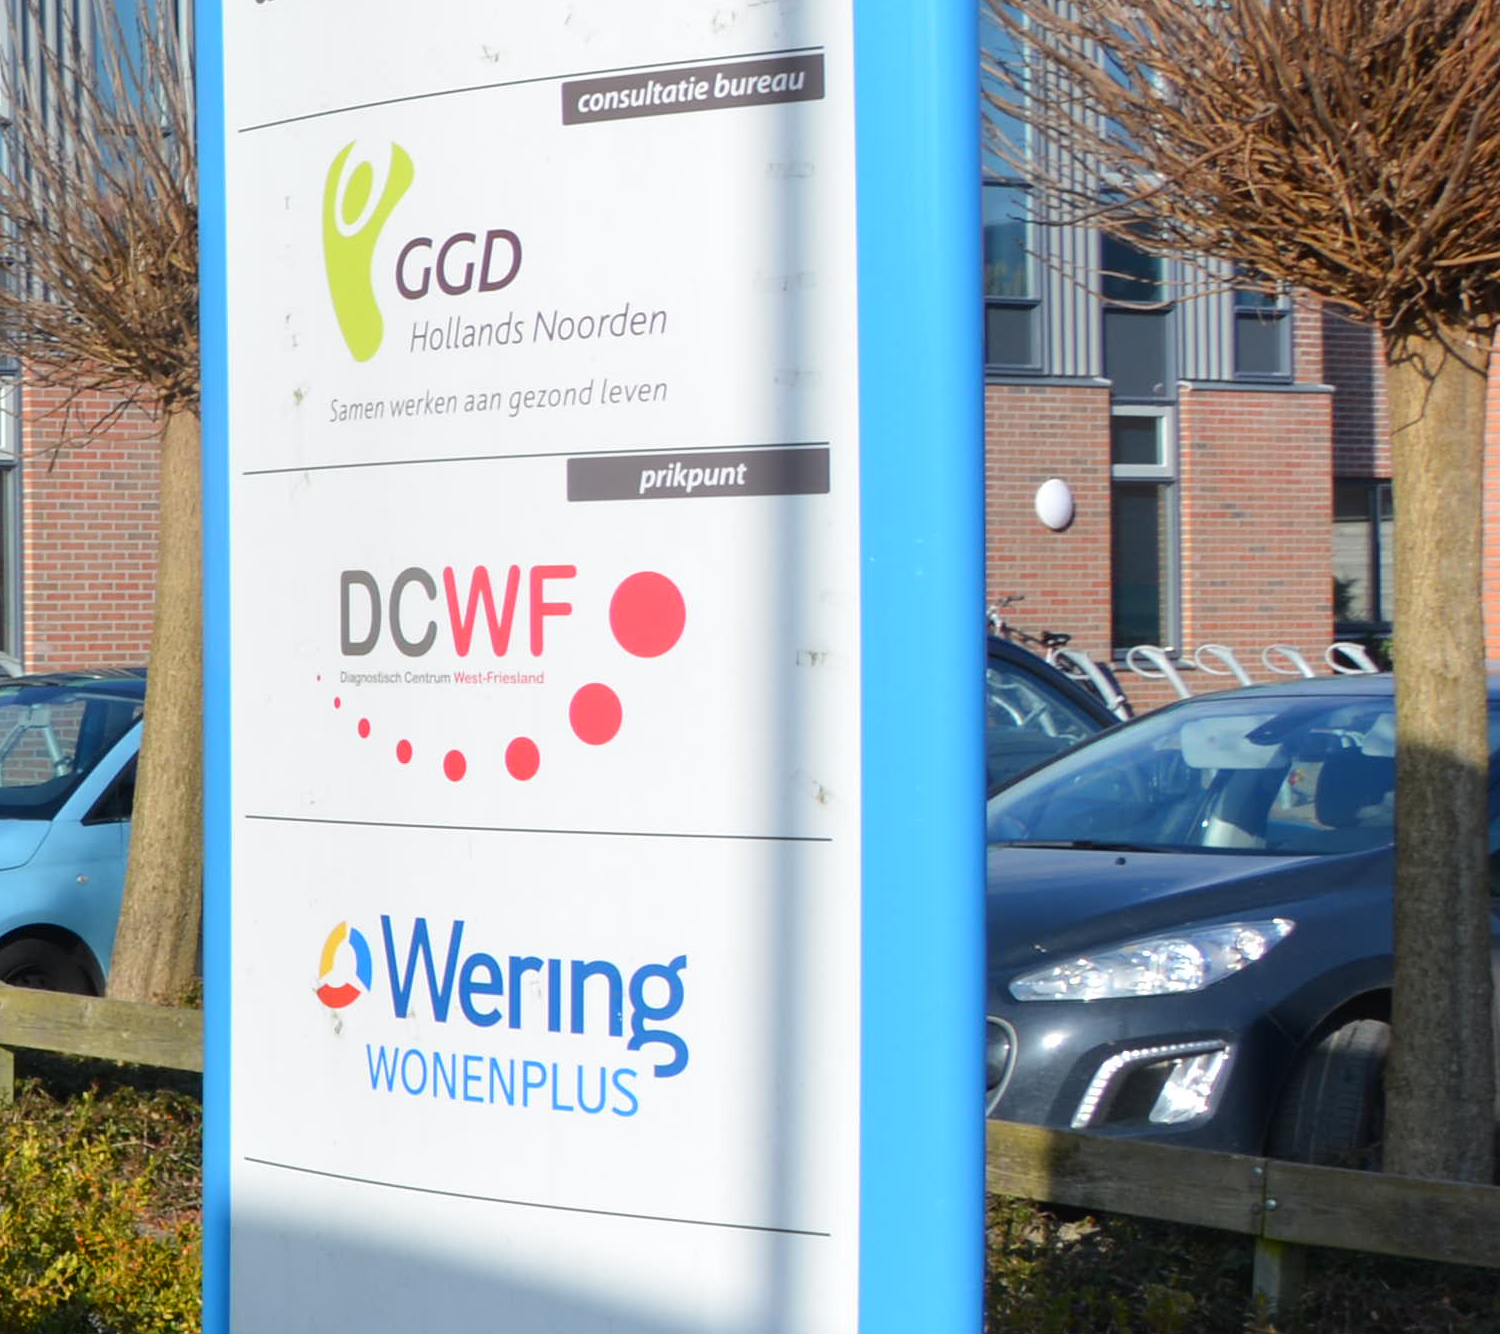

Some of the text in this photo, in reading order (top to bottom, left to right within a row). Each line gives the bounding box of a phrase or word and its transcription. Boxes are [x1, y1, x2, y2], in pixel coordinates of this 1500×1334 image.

[577, 67, 805, 114] consultatie bureau
[395, 228, 523, 301] GGD
[410, 302, 668, 353] Hollands Noorden
[329, 378, 668, 423] Samen werken aan gezond leven
[639, 461, 746, 495] prikpunt
[340, 564, 577, 658] DCWF
[340, 670, 544, 686] Diagnostisch Centrum West-Friesland
[380, 914, 690, 1079] Wering
[366, 1043, 639, 1118] WONENPLUS
